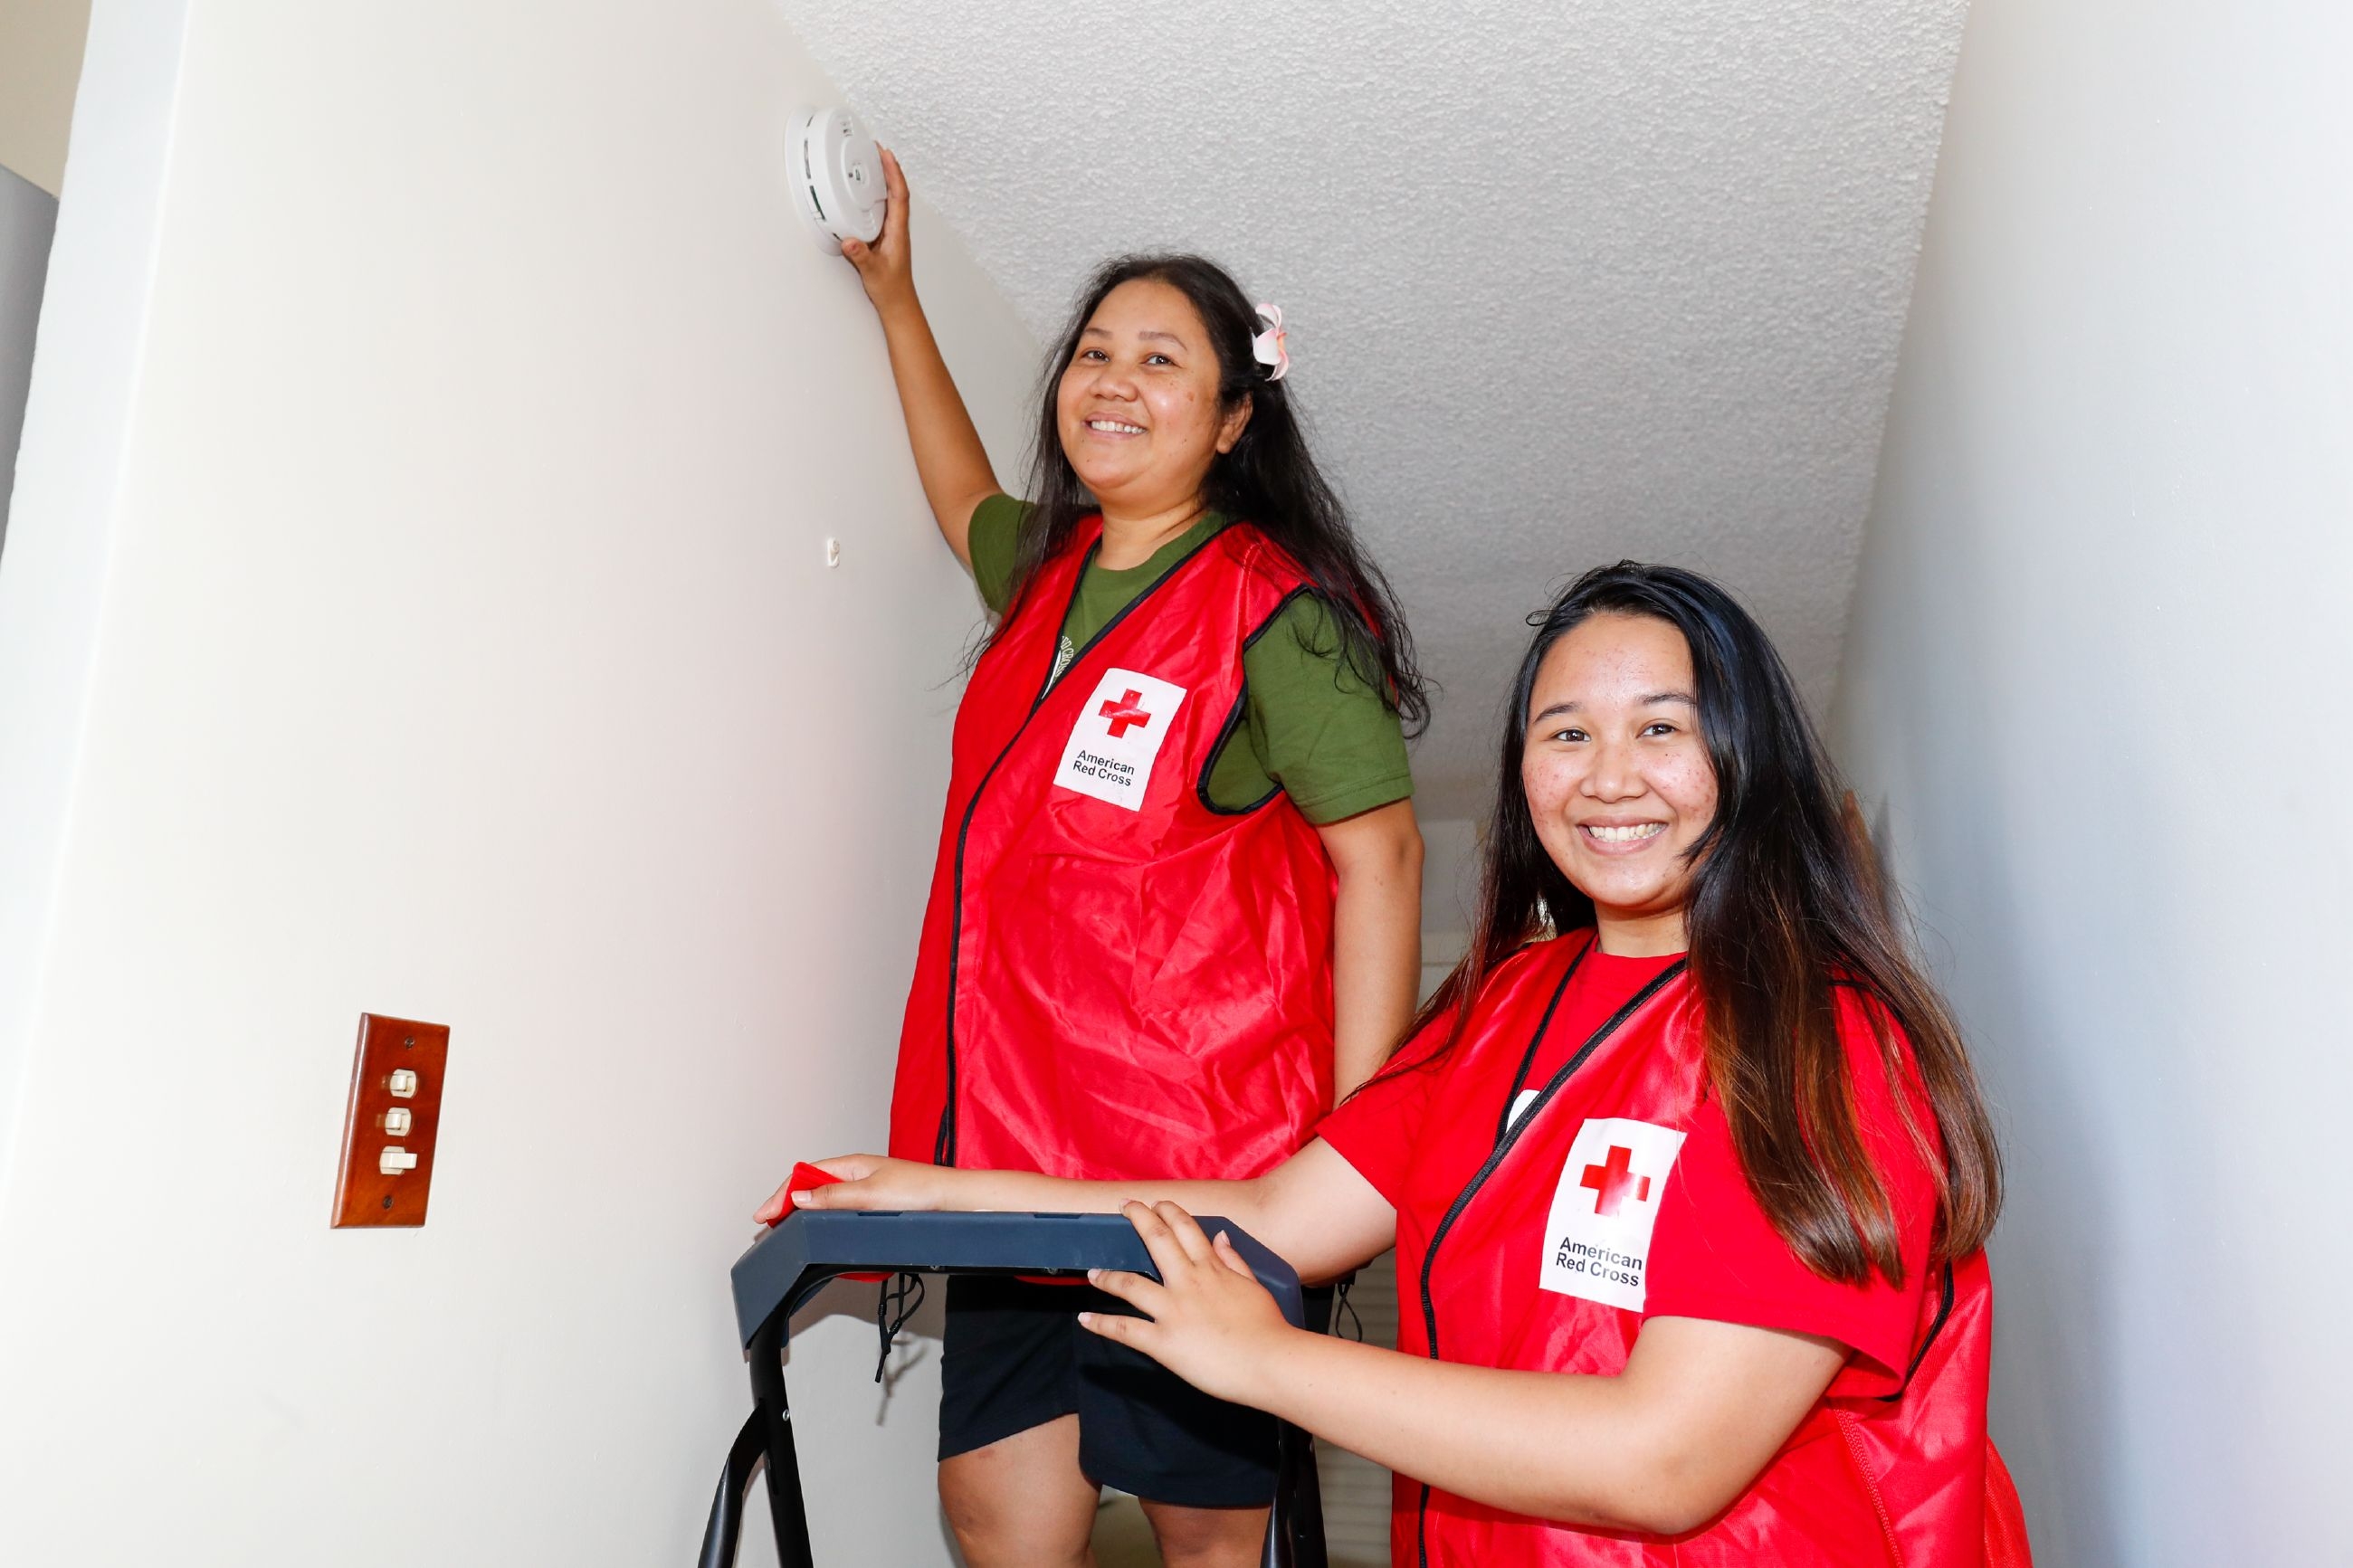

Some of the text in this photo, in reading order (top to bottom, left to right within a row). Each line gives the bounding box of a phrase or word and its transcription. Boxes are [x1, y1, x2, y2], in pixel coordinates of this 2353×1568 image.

[1061, 635, 1072, 650] ED
[1072, 760, 1131, 786] Red Cross
[1077, 749, 1135, 775] American
[1559, 1236, 1643, 1271] American
[1556, 1251, 1639, 1287] Red Cross
